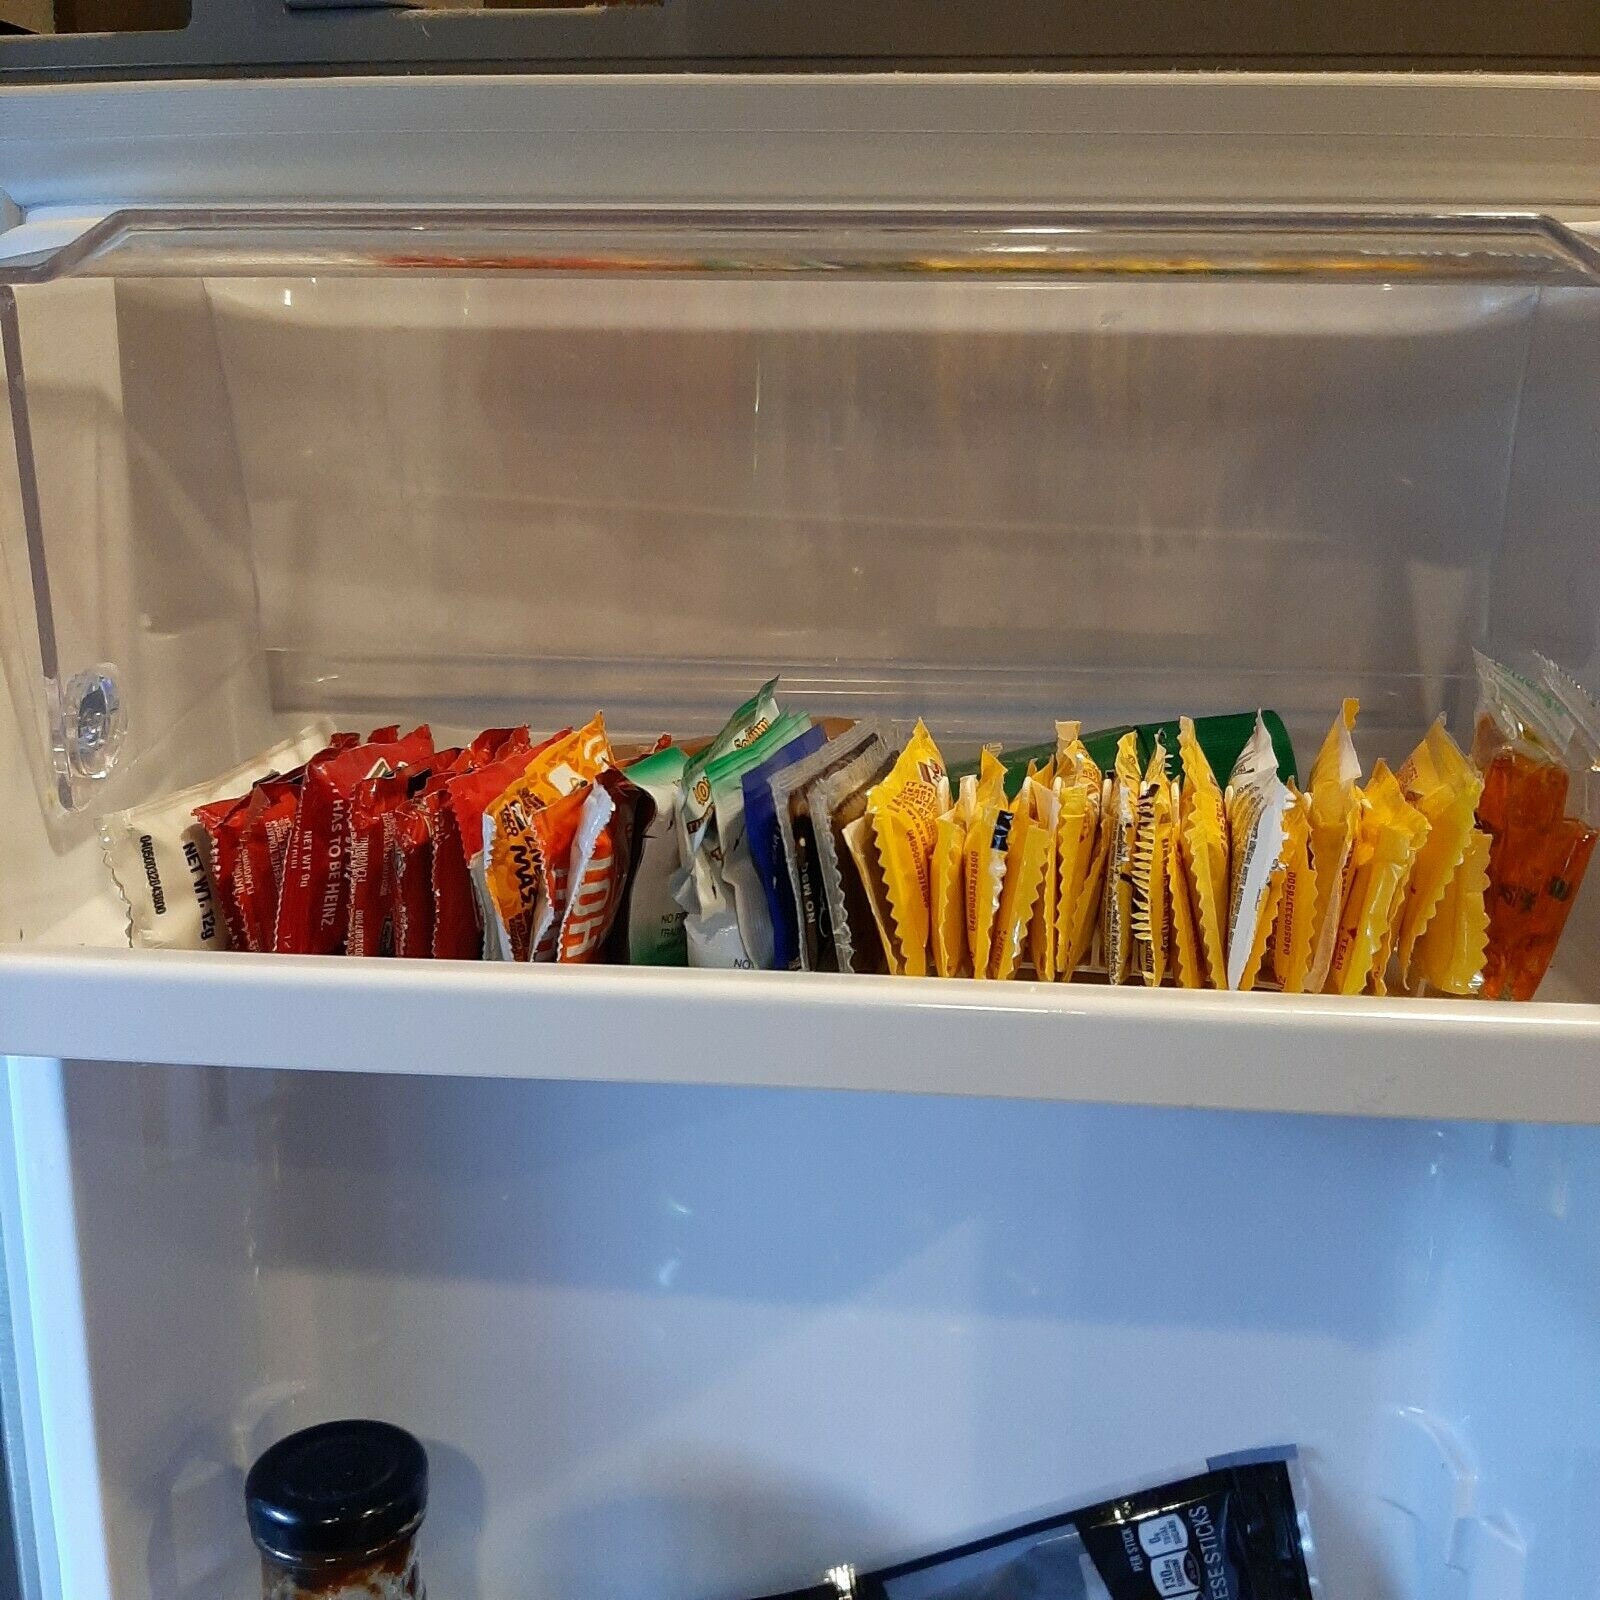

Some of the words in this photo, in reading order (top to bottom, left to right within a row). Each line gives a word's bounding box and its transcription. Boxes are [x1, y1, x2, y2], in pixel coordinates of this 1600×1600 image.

[331, 799, 344, 833] HAS
[303, 831, 313, 850] NET
[328, 836, 342, 858] TO
[182, 842, 205, 874] NET
[302, 854, 312, 870] WT
[328, 861, 342, 880] BE
[194, 876, 212, 908] WT.
[201, 909, 216, 941] 12g
[806, 901, 816, 923] NO
[1334, 938, 1349, 971] TEAR
[1121, 1527, 1139, 1553] STICK
[1189, 1505, 1219, 1563] STICKS
[1131, 1554, 1144, 1572] PER
